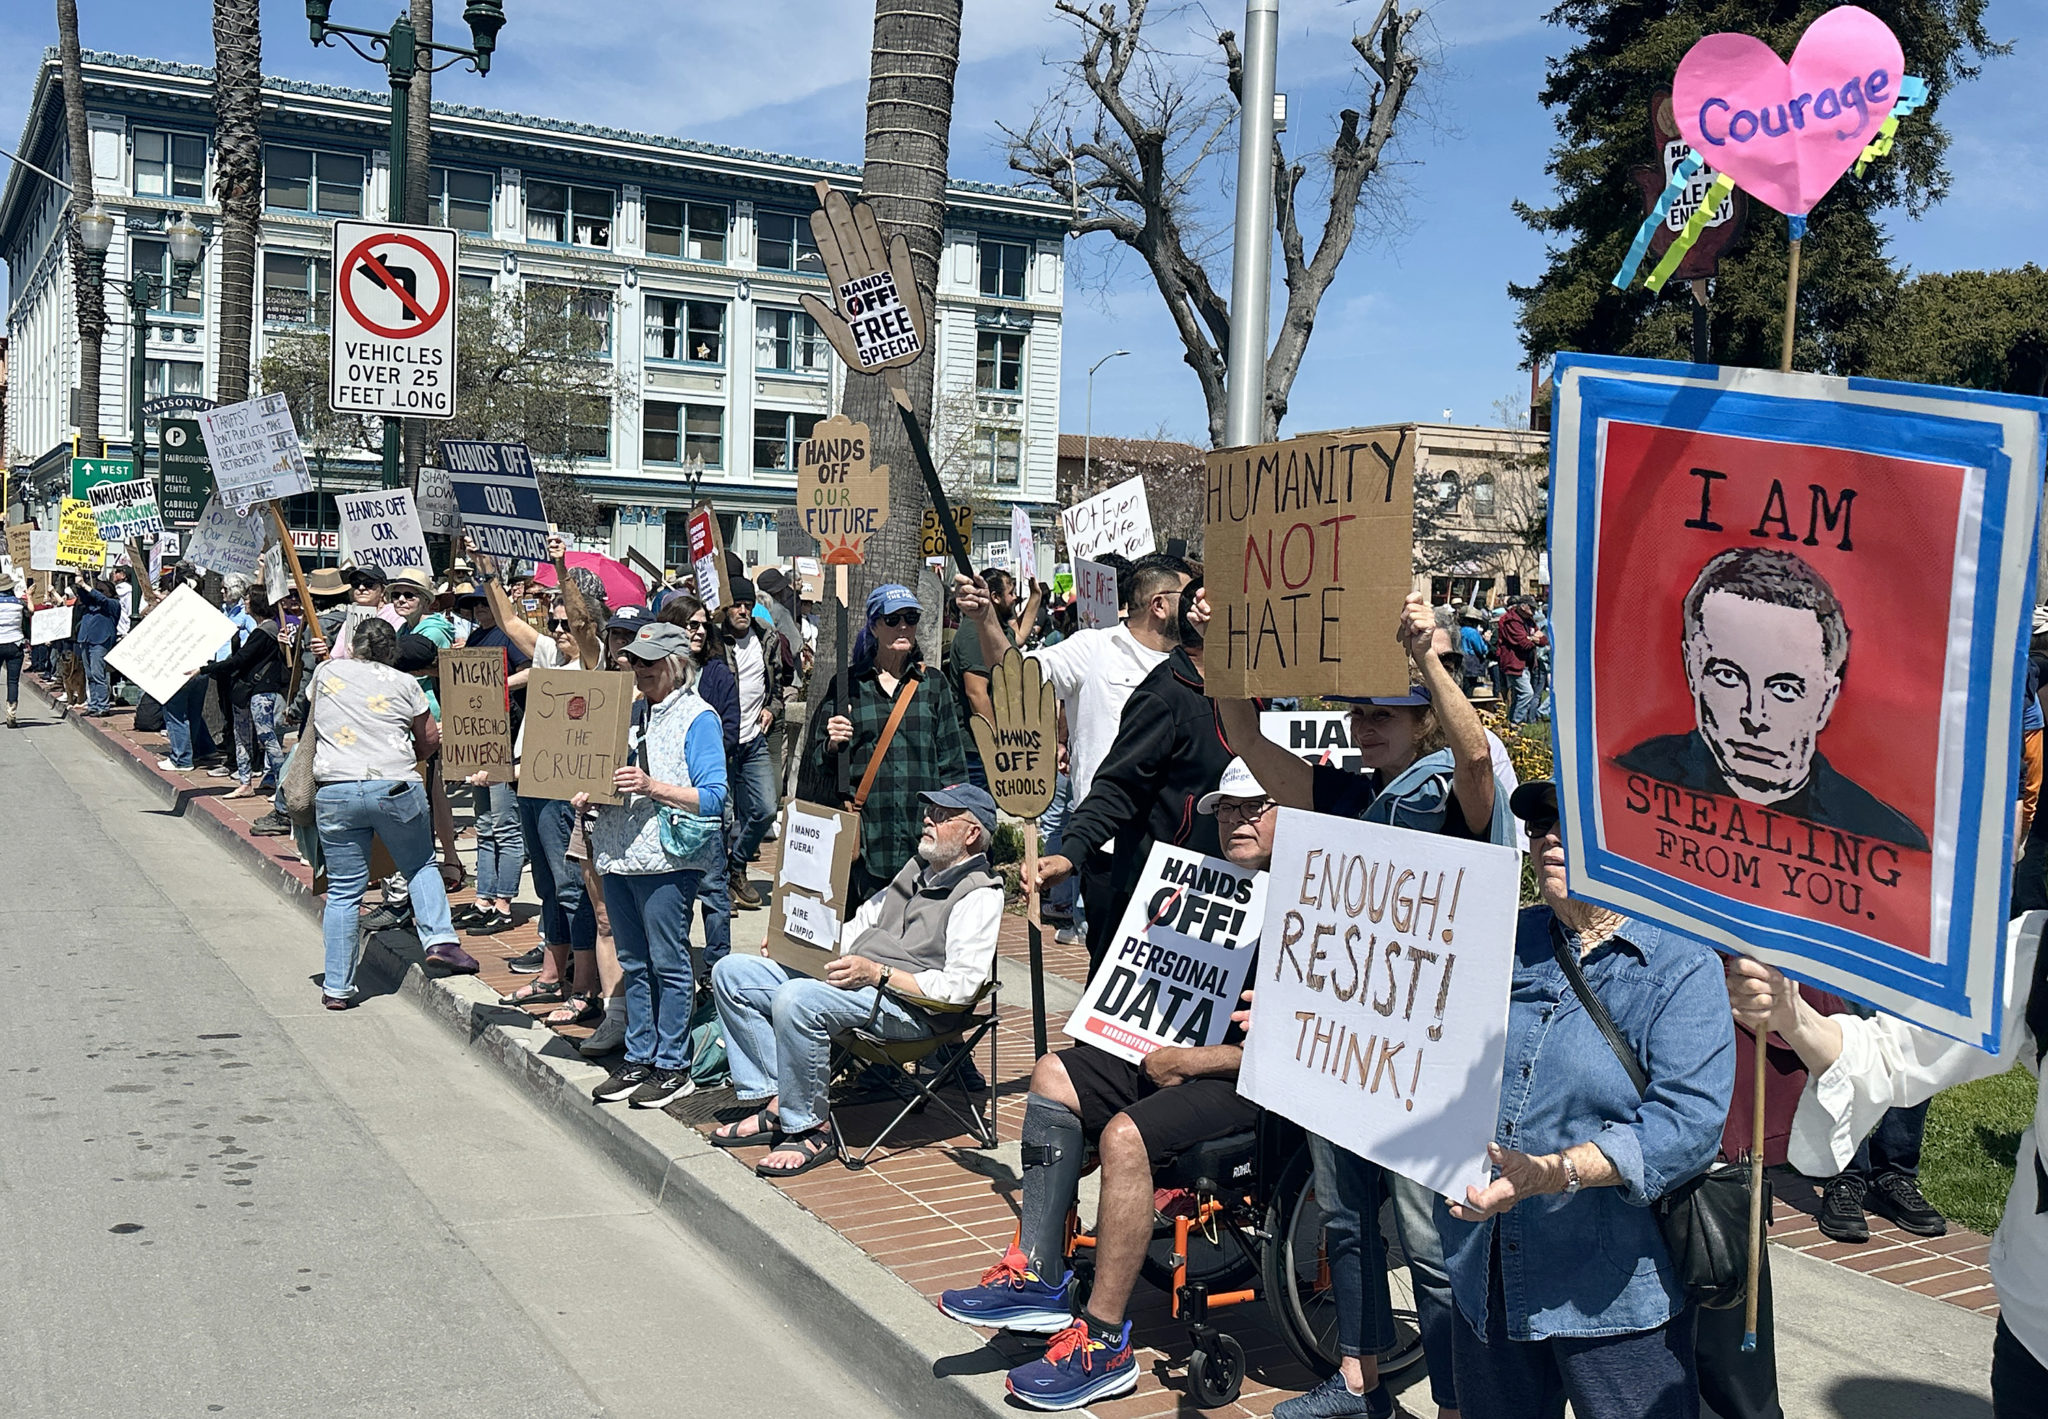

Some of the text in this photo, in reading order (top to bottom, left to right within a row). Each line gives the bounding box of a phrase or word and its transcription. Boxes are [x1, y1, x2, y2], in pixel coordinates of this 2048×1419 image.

[1699, 69, 1890, 146] Courage
[840, 271, 893, 298] HANDS
[846, 285, 899, 317] OFF!
[850, 306, 914, 348] FREE
[345, 341, 443, 366] VEHICLES
[859, 334, 920, 367] SPEECH
[348, 365, 438, 387] OVER 25
[339, 386, 447, 410] FEET LONG
[172, 430, 181, 444] P
[444, 443, 527, 475] HANDS OFF
[805, 438, 865, 466] HANDS
[100, 465, 129, 475] WEST
[164, 474, 188, 484] MELLO
[818, 462, 850, 484] OFF
[1206, 427, 1406, 525] HUMANITY
[164, 484, 191, 494] CENTER
[483, 485, 517, 516] OUR
[814, 488, 851, 506] OUR
[62, 501, 91, 517] HANDS
[95, 502, 159, 526] HARDWORKING
[116, 499, 133, 509] ARE
[164, 500, 199, 509] CABRILLO
[164, 509, 195, 519] COLLEGE
[345, 495, 407, 521] HANDS OFF
[1103, 495, 1139, 526] Even
[1684, 467, 1858, 551] I AM
[99, 517, 163, 541] GOOD PEOPLE!
[371, 522, 398, 541] OUR
[806, 507, 878, 535] FUTURE
[204, 527, 224, 541] Our
[465, 524, 551, 561] DEMOCRACY
[62, 546, 101, 556] FREEDOM
[221, 548, 256, 569] RIGHTS
[353, 545, 424, 568] DEMOCRACY
[1243, 515, 1356, 594] NOT
[55, 559, 103, 570] DEMOCRACY
[1076, 567, 1113, 606] WE ARE
[1228, 587, 1345, 670] HATE
[451, 659, 503, 688] MIGRAR
[453, 715, 507, 736] DERECHO
[565, 729, 592, 746] THE
[1290, 720, 1359, 749] HA
[1000, 729, 1042, 750] HANDS
[446, 741, 511, 766] UNIVERSAL
[995, 751, 1040, 773] OFF
[995, 777, 1046, 797] SCHOOLS
[794, 824, 820, 839] MANOS
[1626, 774, 1902, 887] STEALING
[1159, 857, 1253, 905] HANDS
[1655, 828, 1876, 920] FROM YOU.
[1299, 848, 1466, 945] ENOUGH!
[791, 906, 809, 921] AIRE
[1146, 887, 1247, 950] OFF!
[789, 922, 814, 940] LIMPIO
[1118, 936, 1229, 999] PERSONAL
[1273, 909, 1457, 1041] RESIST!
[1093, 965, 1215, 1047] DATA
[1295, 1011, 1424, 1112] THINK!
[1101, 1331, 1122, 1343] FILA
[1105, 1344, 1132, 1372] HOKA
